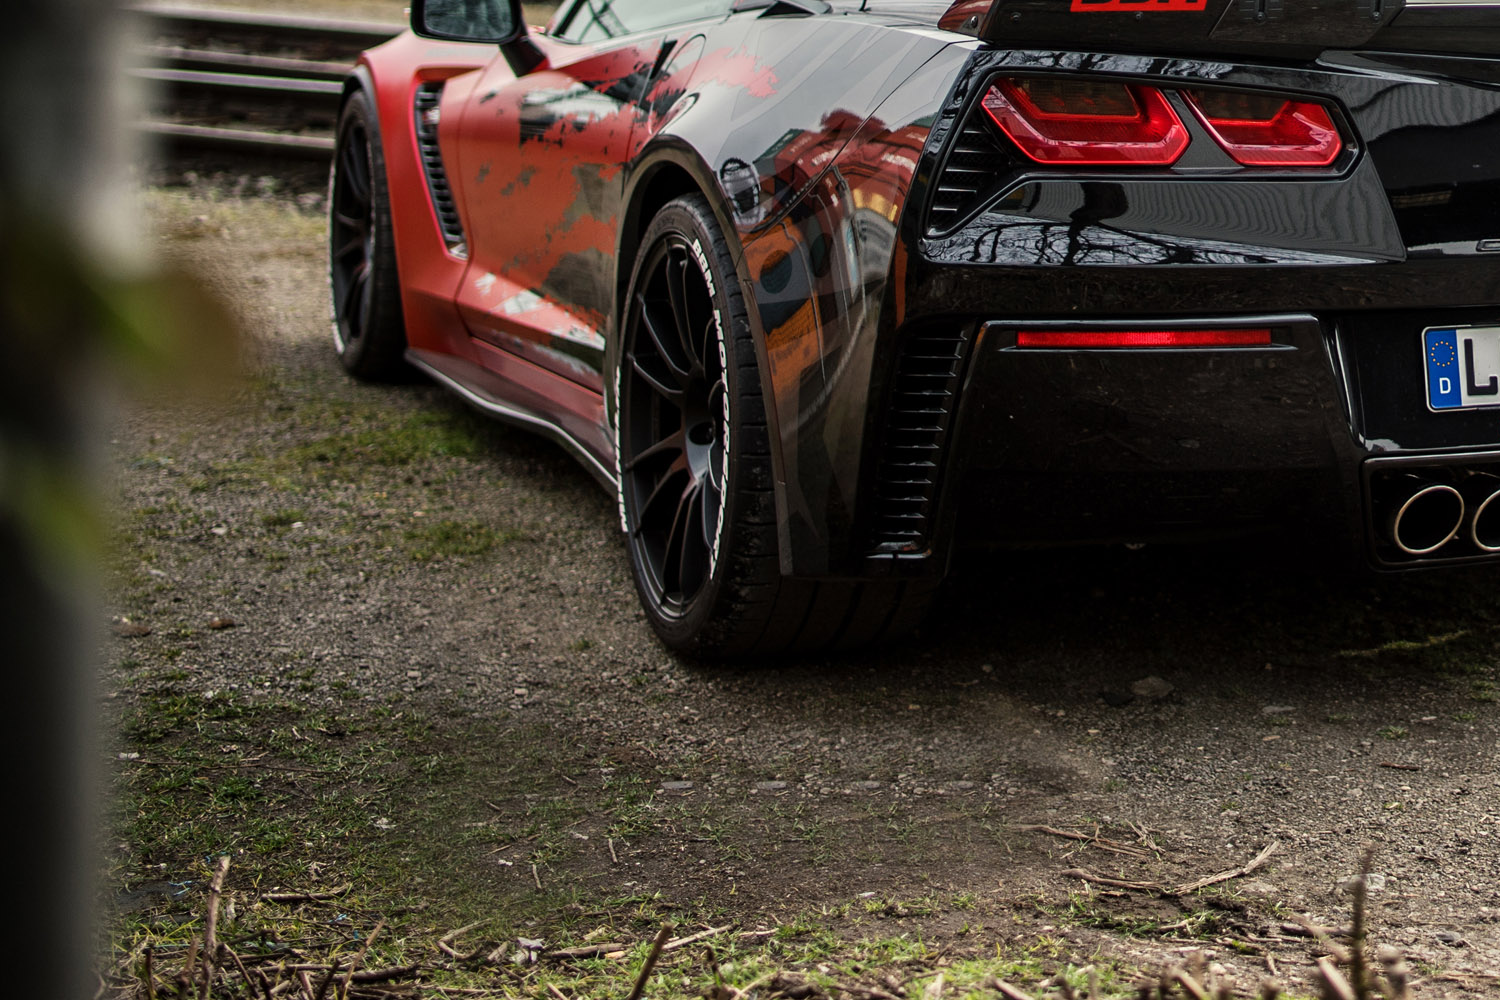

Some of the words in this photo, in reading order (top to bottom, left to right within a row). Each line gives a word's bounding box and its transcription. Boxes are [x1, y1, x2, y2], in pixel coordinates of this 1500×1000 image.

[692, 238, 716, 297] BBM
[710, 309, 730, 580] MOTORSPORT
[1439, 377, 1451, 395] D
